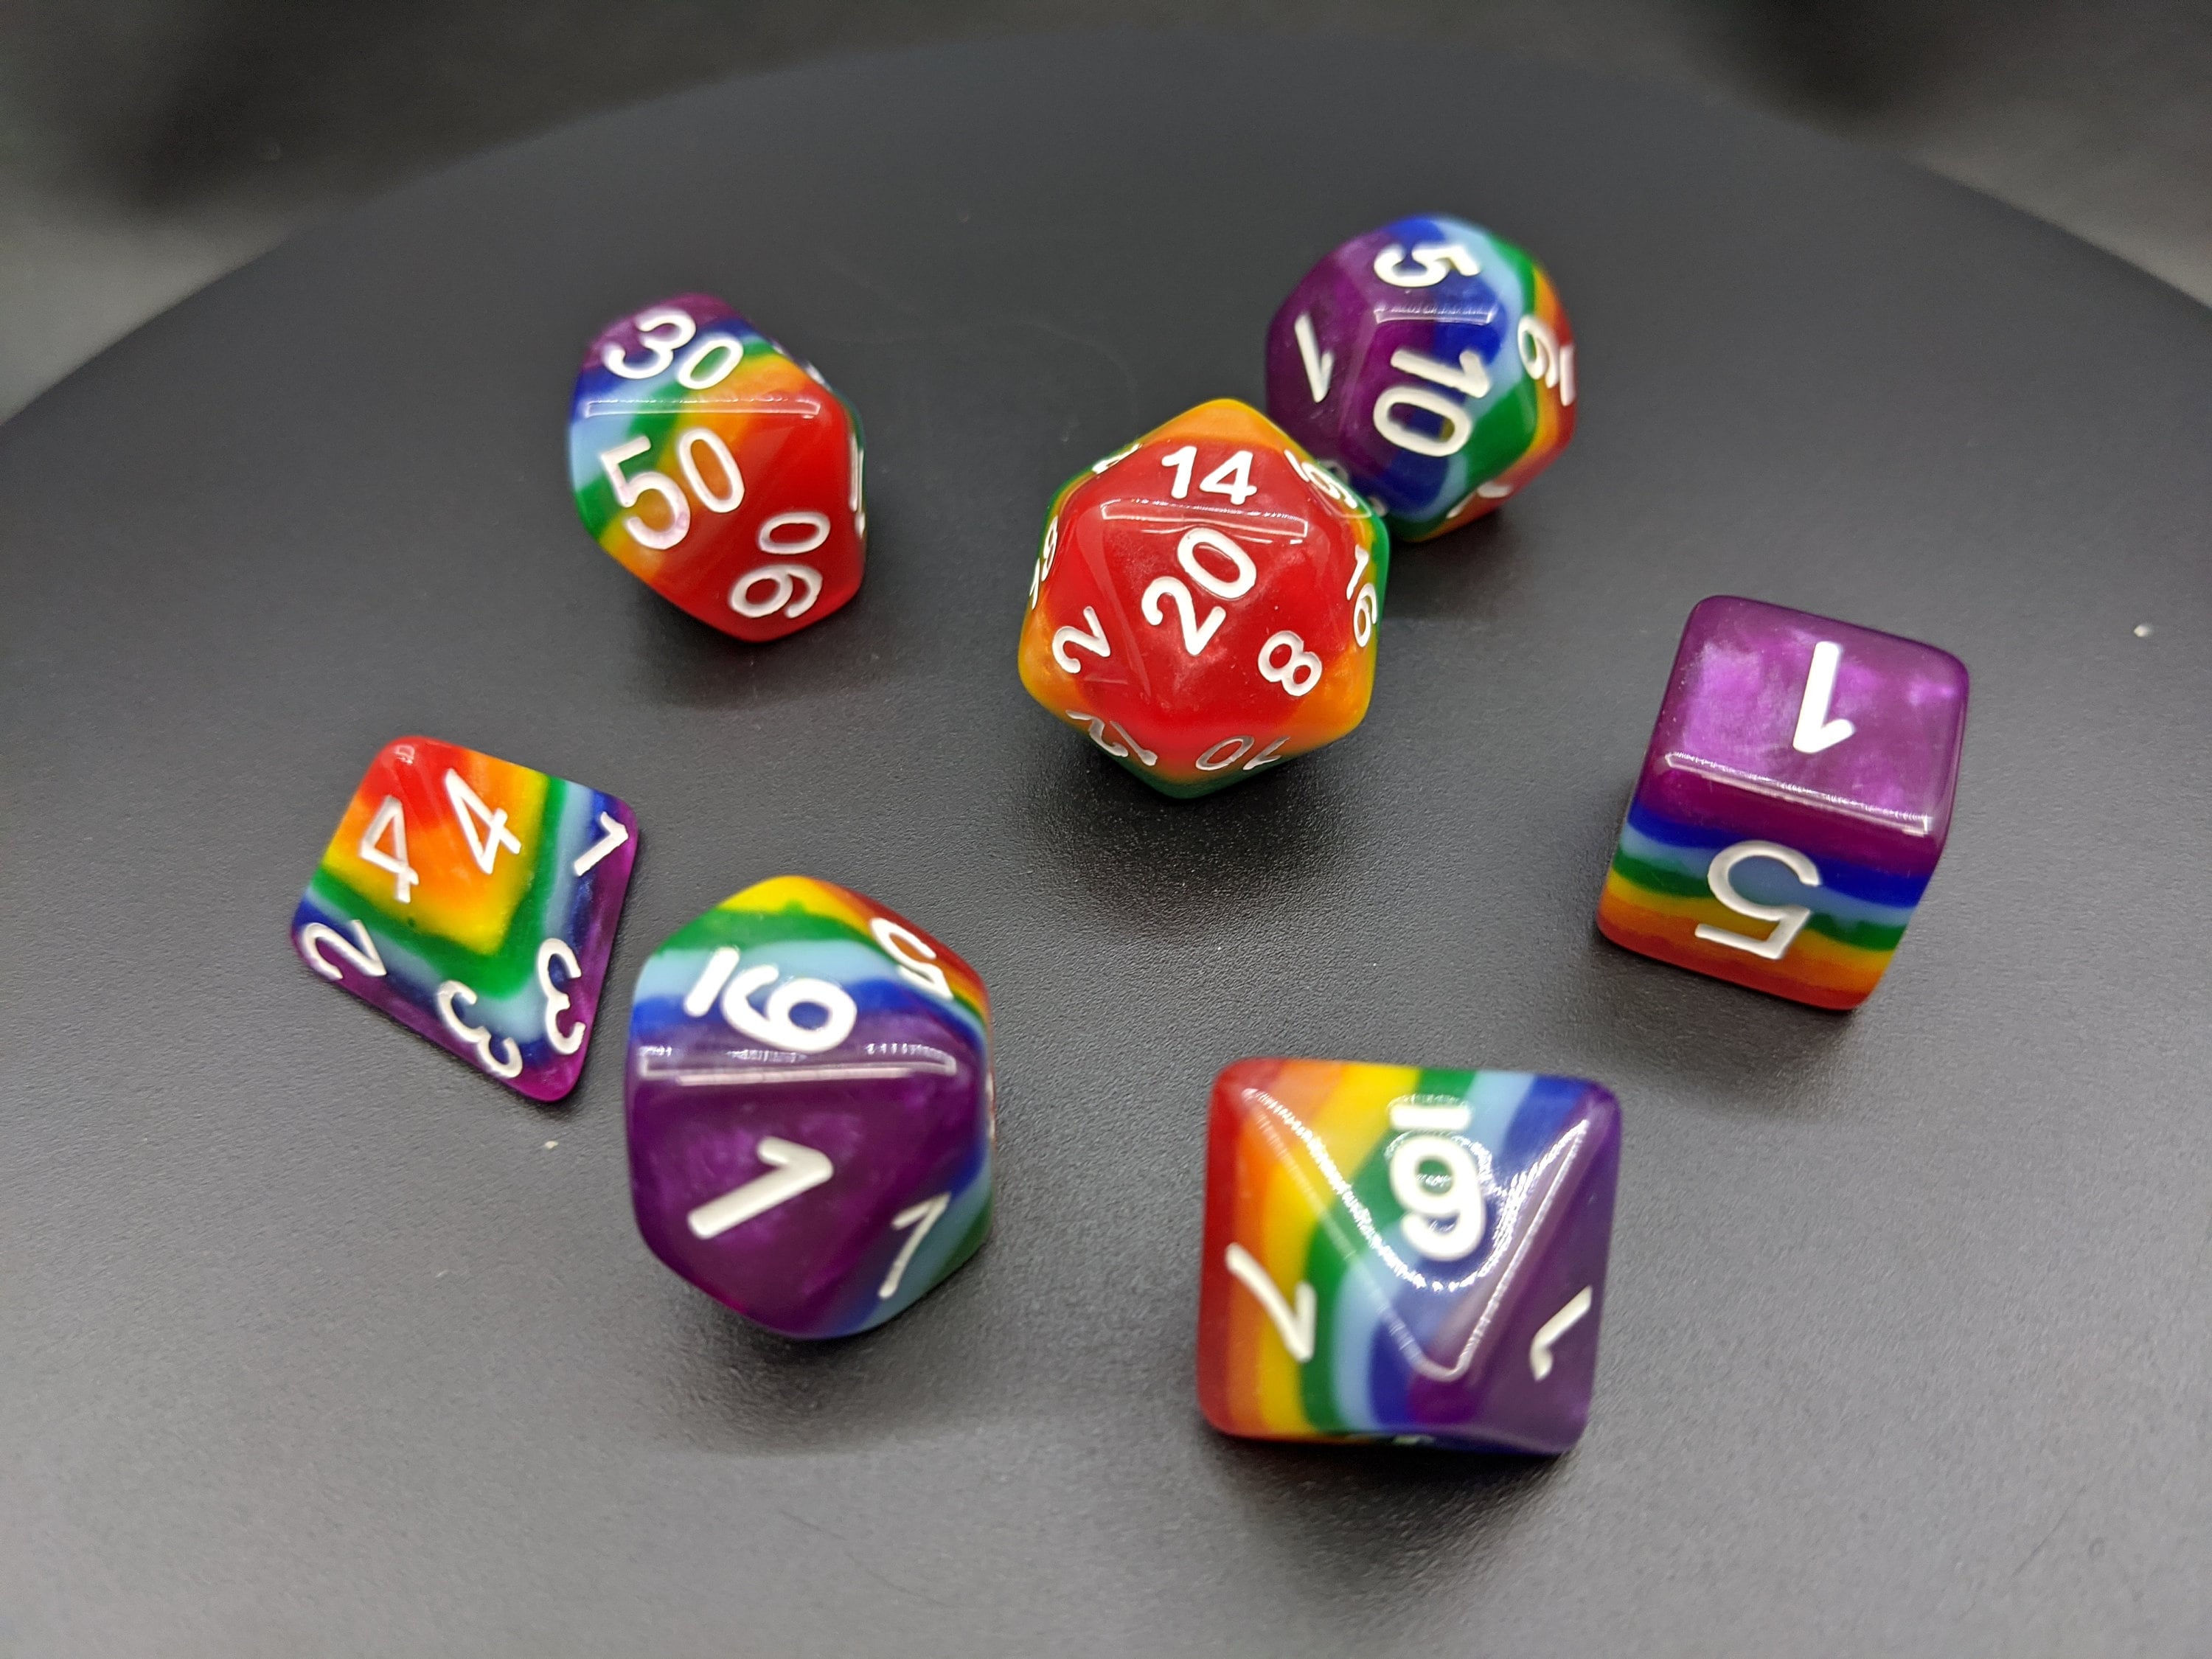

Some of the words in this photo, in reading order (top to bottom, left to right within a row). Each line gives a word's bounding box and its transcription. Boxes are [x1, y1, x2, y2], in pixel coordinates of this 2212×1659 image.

[1374, 243, 1481, 288] 5
[603, 307, 744, 390] 30
[1373, 348, 1491, 457] 10
[600, 427, 745, 550] 50
[1161, 445, 1257, 505] 14
[728, 512, 832, 619] 90
[1141, 526, 1256, 656] 20
[1346, 544, 1377, 647] 16
[1051, 606, 1111, 674] 2
[1257, 630, 1323, 697] 8
[1792, 641, 1856, 754] 1
[359, 795, 419, 904] 4
[445, 768, 522, 874] 4
[573, 811, 629, 877] 1
[300, 919, 387, 981] 2
[1695, 839, 1820, 959] 5
[437, 979, 523, 1078] 3
[537, 938, 586, 1054] 3
[686, 1135, 835, 1239] 1
